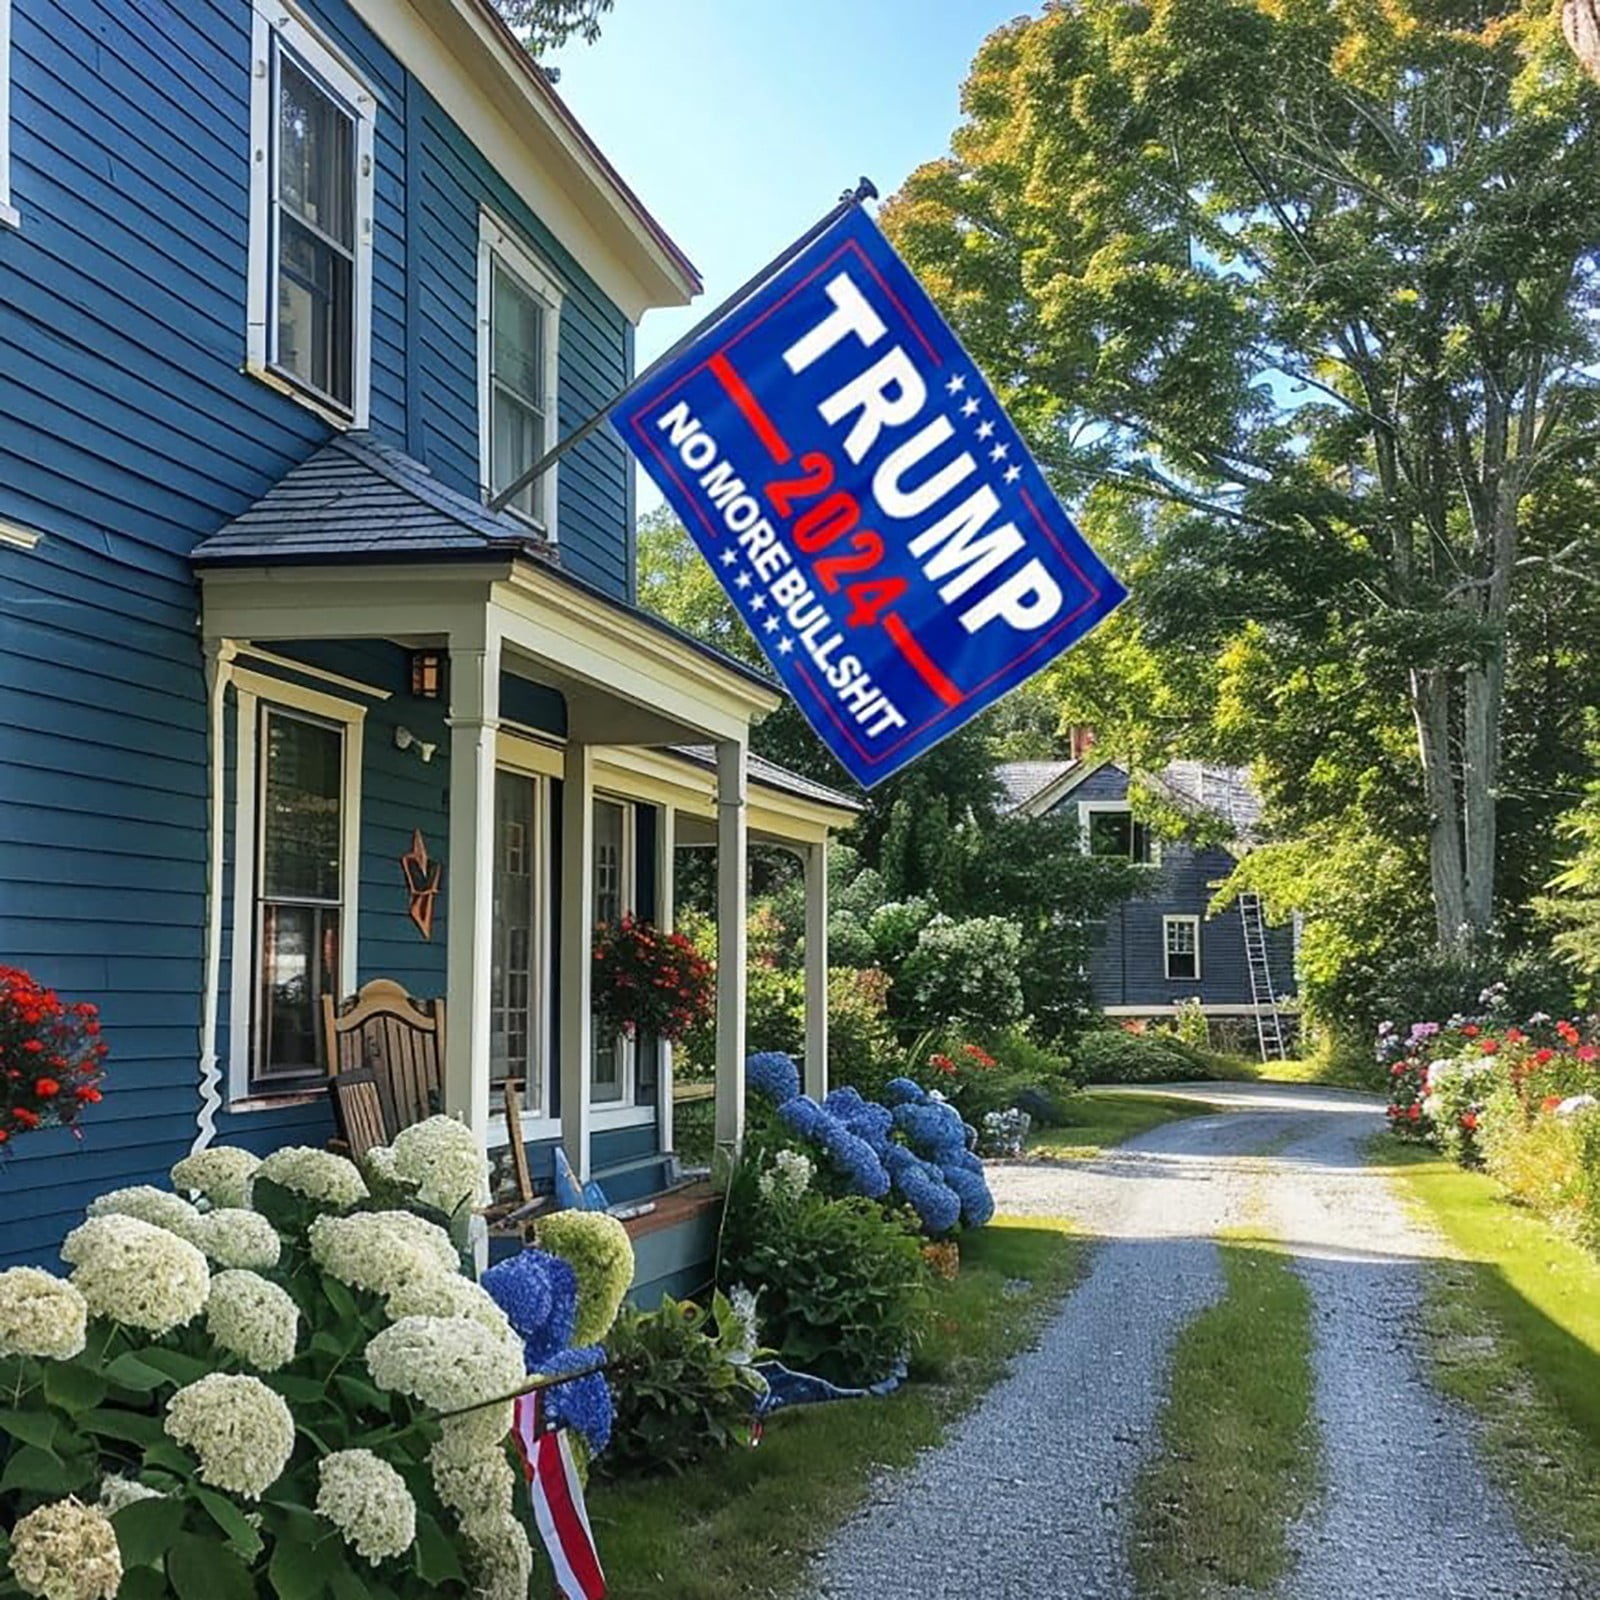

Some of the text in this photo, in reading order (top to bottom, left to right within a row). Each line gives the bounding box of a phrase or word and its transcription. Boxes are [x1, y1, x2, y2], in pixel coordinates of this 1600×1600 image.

[657, 401, 907, 739] NO MORE BULLSHIT
[763, 452, 908, 628] 2024
[782, 271, 1063, 635] TRUMP
